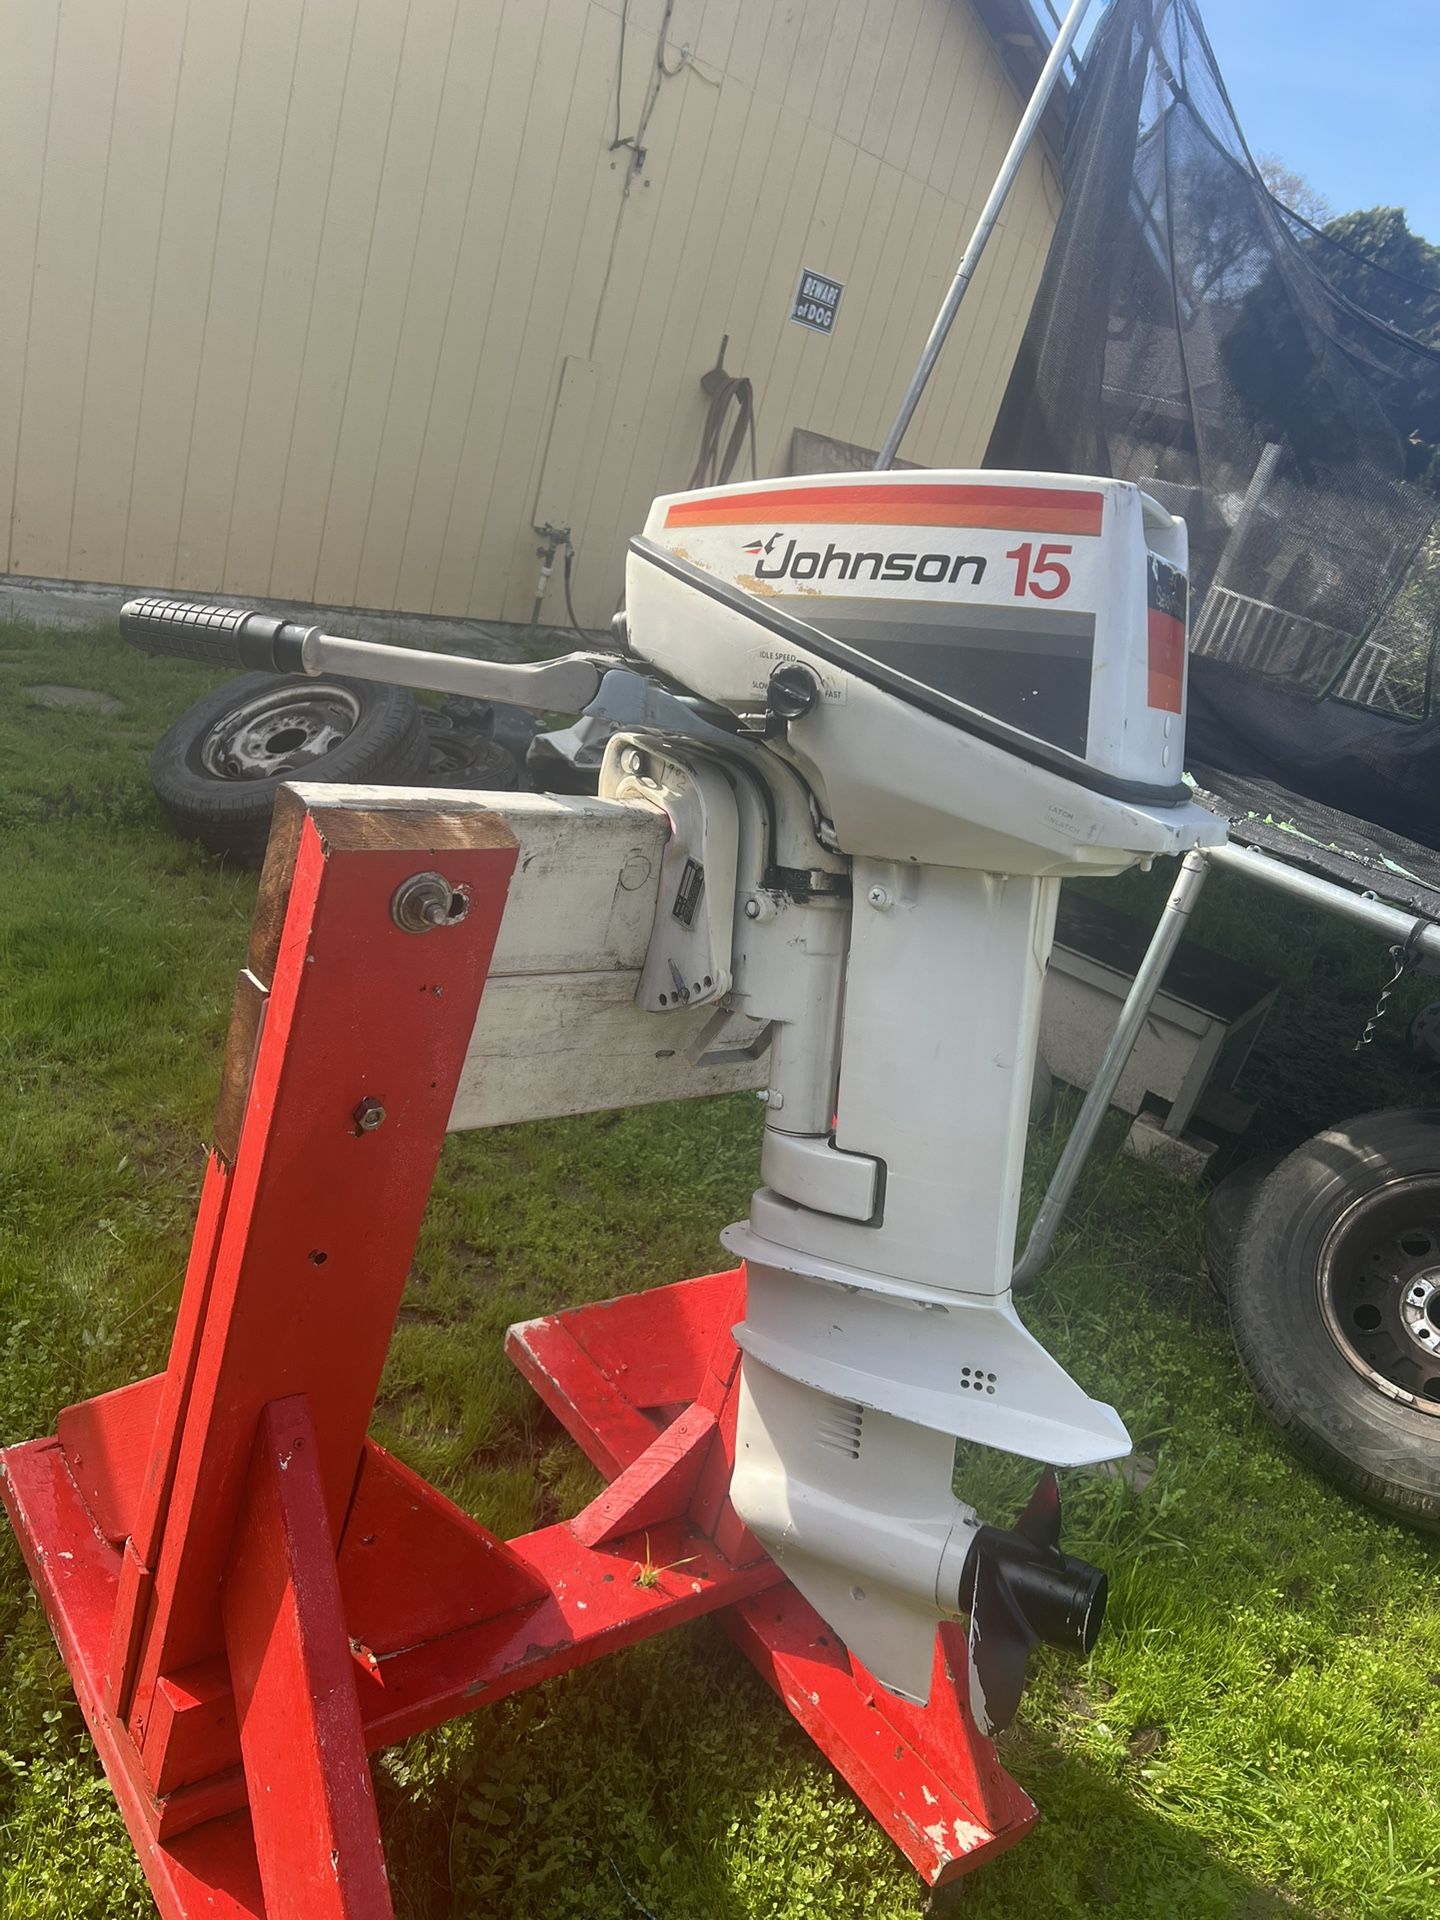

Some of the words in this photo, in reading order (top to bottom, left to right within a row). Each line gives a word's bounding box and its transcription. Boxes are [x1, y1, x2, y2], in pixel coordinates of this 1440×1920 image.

[797, 303, 810, 317] of
[807, 304, 832, 326] DOG
[754, 539, 987, 584] Johnson
[1005, 542, 1073, 600] 15
[760, 651, 774, 660] IDLE
[775, 652, 797, 662] SPEED
[824, 690, 842, 699] FAST
[1048, 805, 1074, 820] LATCH
